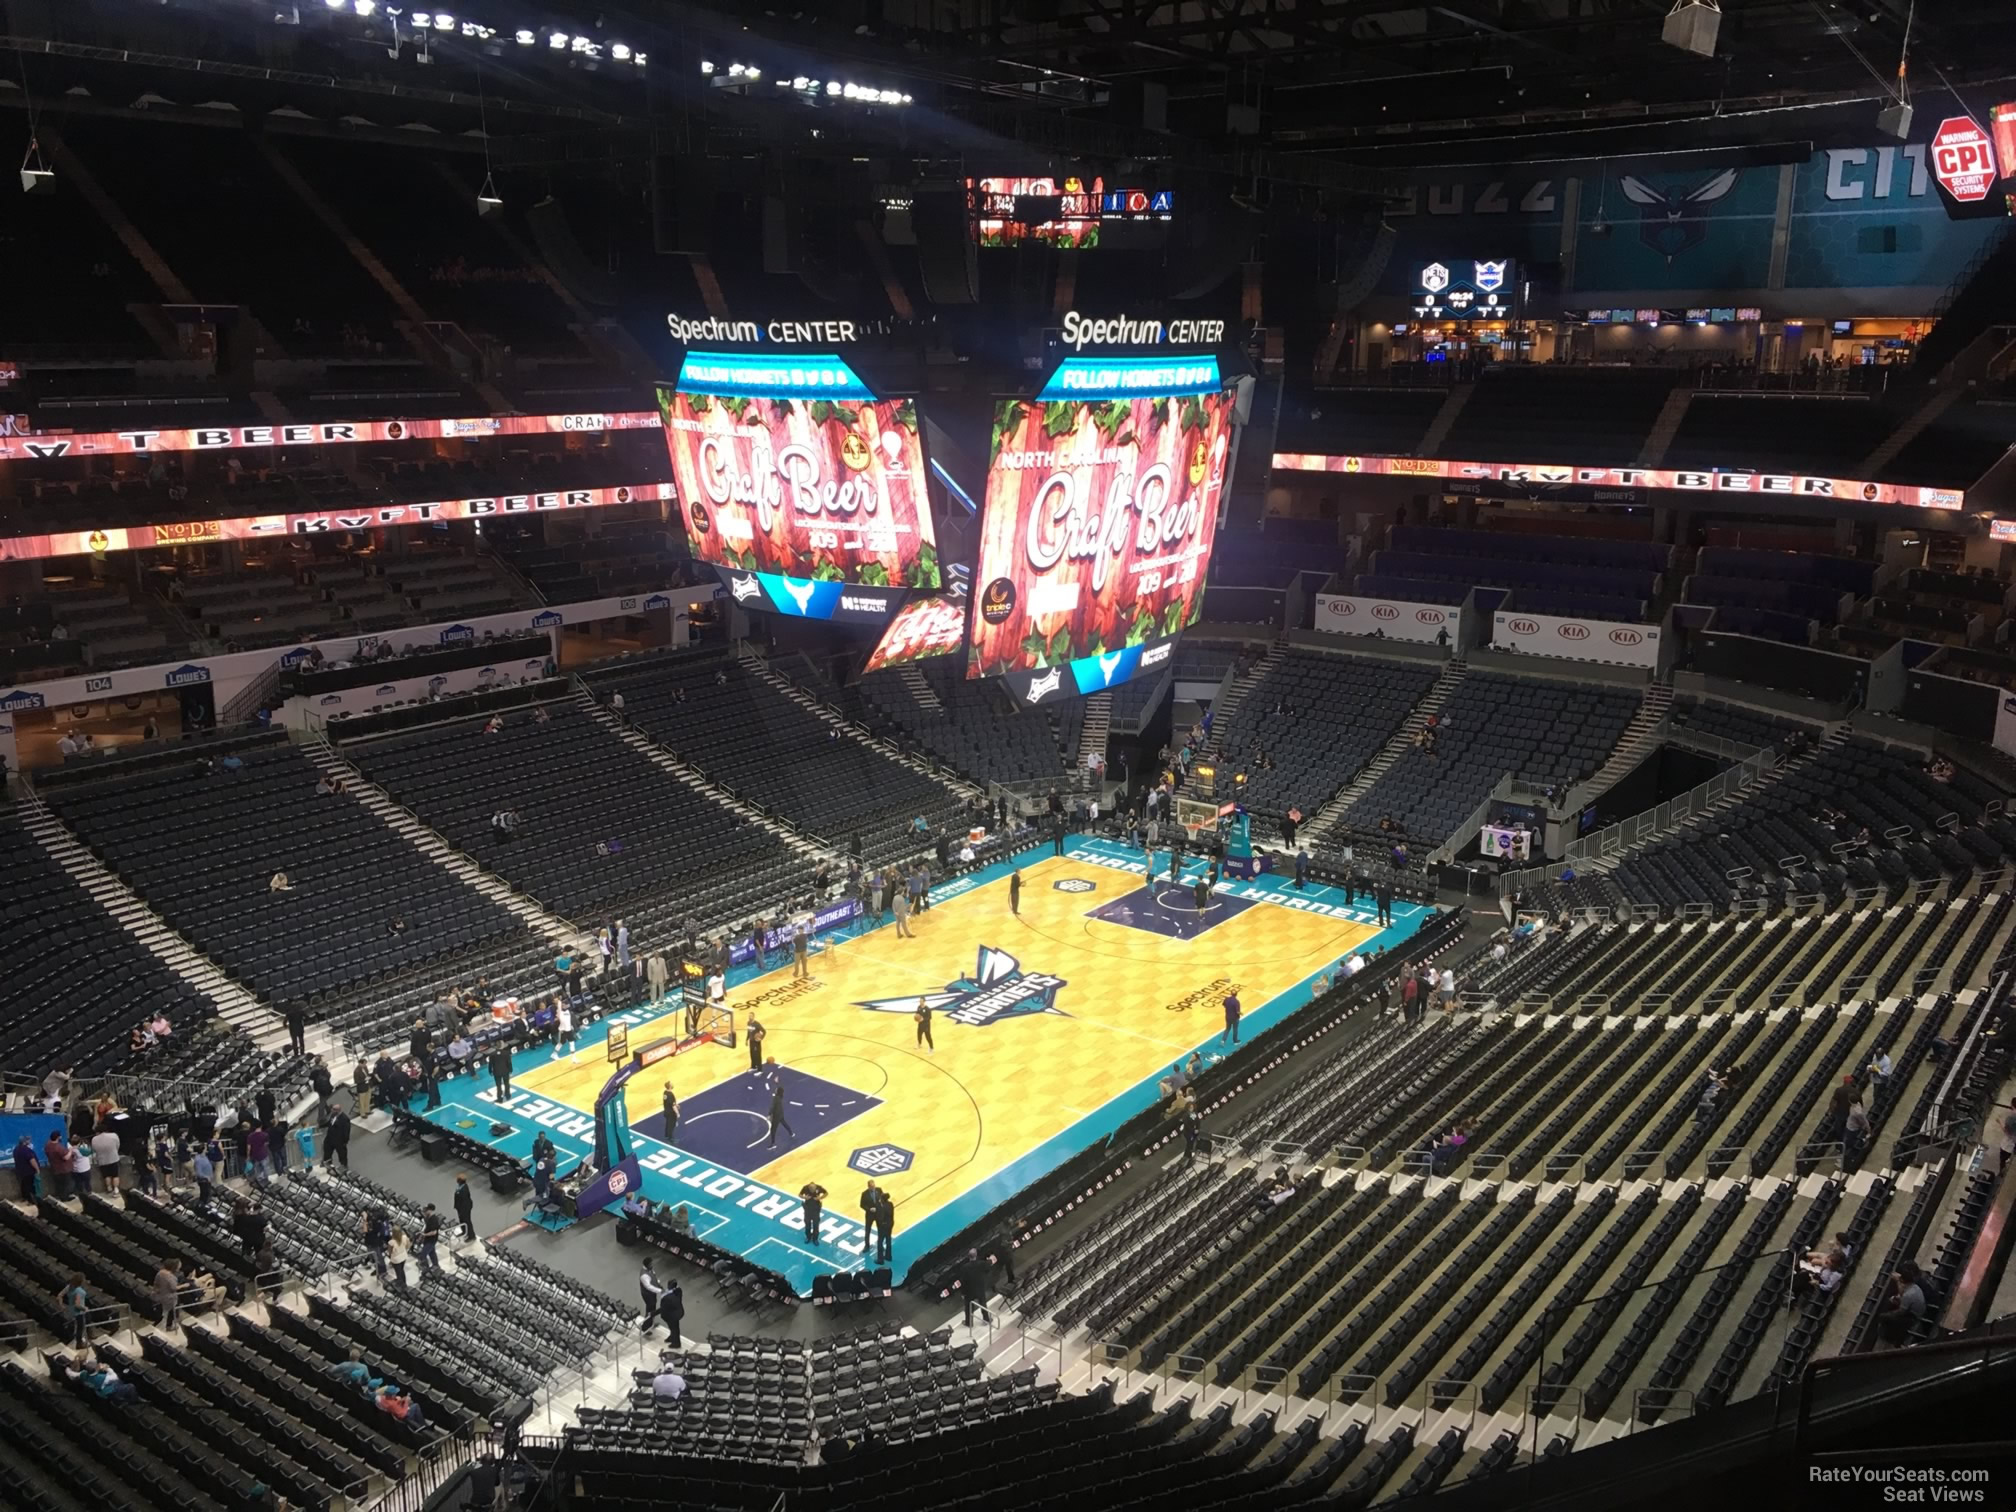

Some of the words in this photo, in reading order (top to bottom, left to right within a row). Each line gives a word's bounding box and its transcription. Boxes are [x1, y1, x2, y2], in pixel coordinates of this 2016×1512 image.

[1941, 130, 1979, 144] WARNING
[1937, 146, 1991, 175] CPI
[1826, 144, 1929, 200] CIT
[1951, 174, 1984, 187] SECURITY
[1954, 183, 1986, 196] SYSTEMS
[667, 313, 760, 344] Spectrum
[767, 318, 857, 343] CENTER
[1062, 311, 1161, 351] Spectrum
[1168, 320, 1224, 344] CENTER
[1063, 369, 1120, 389] FOLLOW
[1121, 368, 1174, 387] HORNETS
[195, 425, 356, 449] BEER
[1001, 451, 1053, 471] NORTH
[699, 436, 782, 532] Craft
[778, 443, 879, 515] Beer
[1675, 472, 1835, 497] BEER
[468, 491, 593, 517] BEER
[1594, 490, 1635, 501] HORNETS
[1026, 470, 1134, 593] Craft
[1134, 462, 1201, 555] Beer
[1332, 603, 1351, 614] KIA
[1375, 606, 1396, 619] KIA
[1419, 610, 1440, 623] KIA
[1513, 621, 1535, 634] KIA
[1562, 626, 1585, 639] KIA
[1614, 631, 1637, 644] KIA
[87, 678, 111, 692] 104
[169, 669, 208, 686] LOWE'S
[732, 977, 810, 1011] Spectrum
[769, 981, 827, 1007] CENTER
[949, 973, 1061, 1025] HORNETS
[1165, 979, 1227, 1012] Spectrum
[856, 1147, 896, 1169] BUZZ
[869, 1152, 906, 1173] CITY
[611, 1175, 627, 1190] CPI
